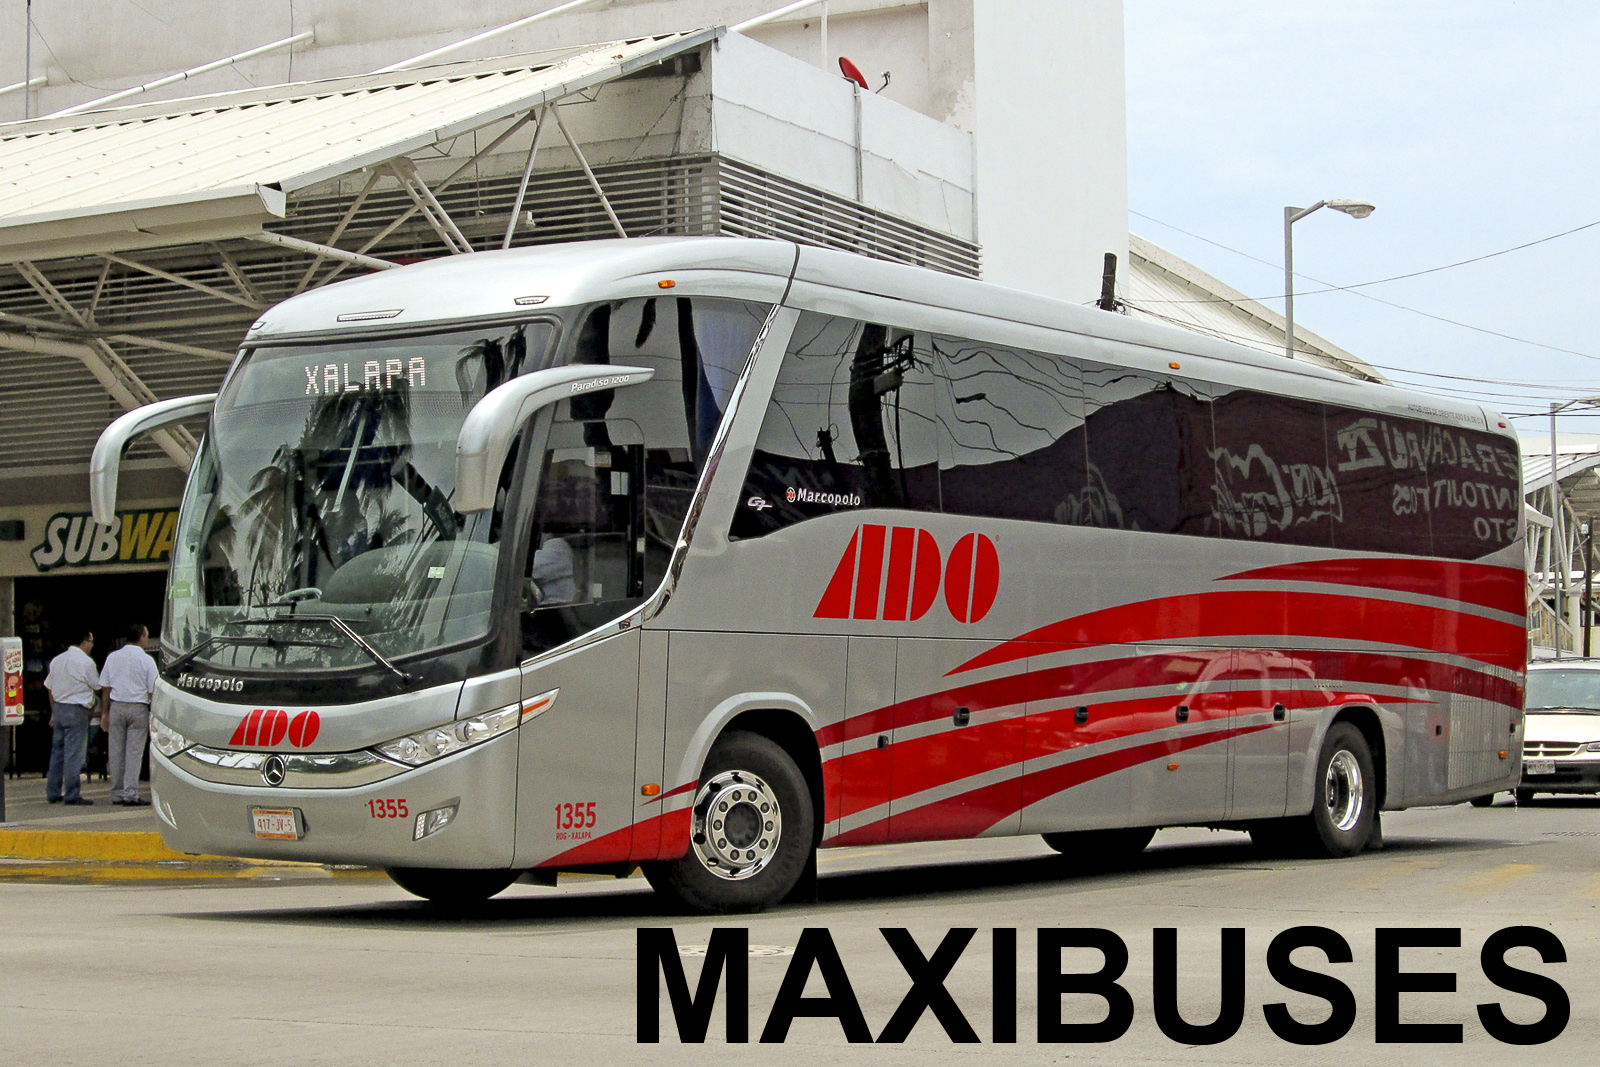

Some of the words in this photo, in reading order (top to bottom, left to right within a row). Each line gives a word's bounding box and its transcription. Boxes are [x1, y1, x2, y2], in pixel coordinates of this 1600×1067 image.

[303, 356, 427, 396] XALAPA
[570, 378, 609, 393] Paradiso
[611, 375, 630, 385] 1200
[797, 487, 861, 506] Marcopolo
[32, 511, 179, 565] SUBWA
[812, 523, 1000, 624] ADO
[176, 672, 244, 692] Marcopolo
[228, 709, 320, 748] ADO
[368, 798, 409, 819] 1355
[555, 802, 597, 830] 1355
